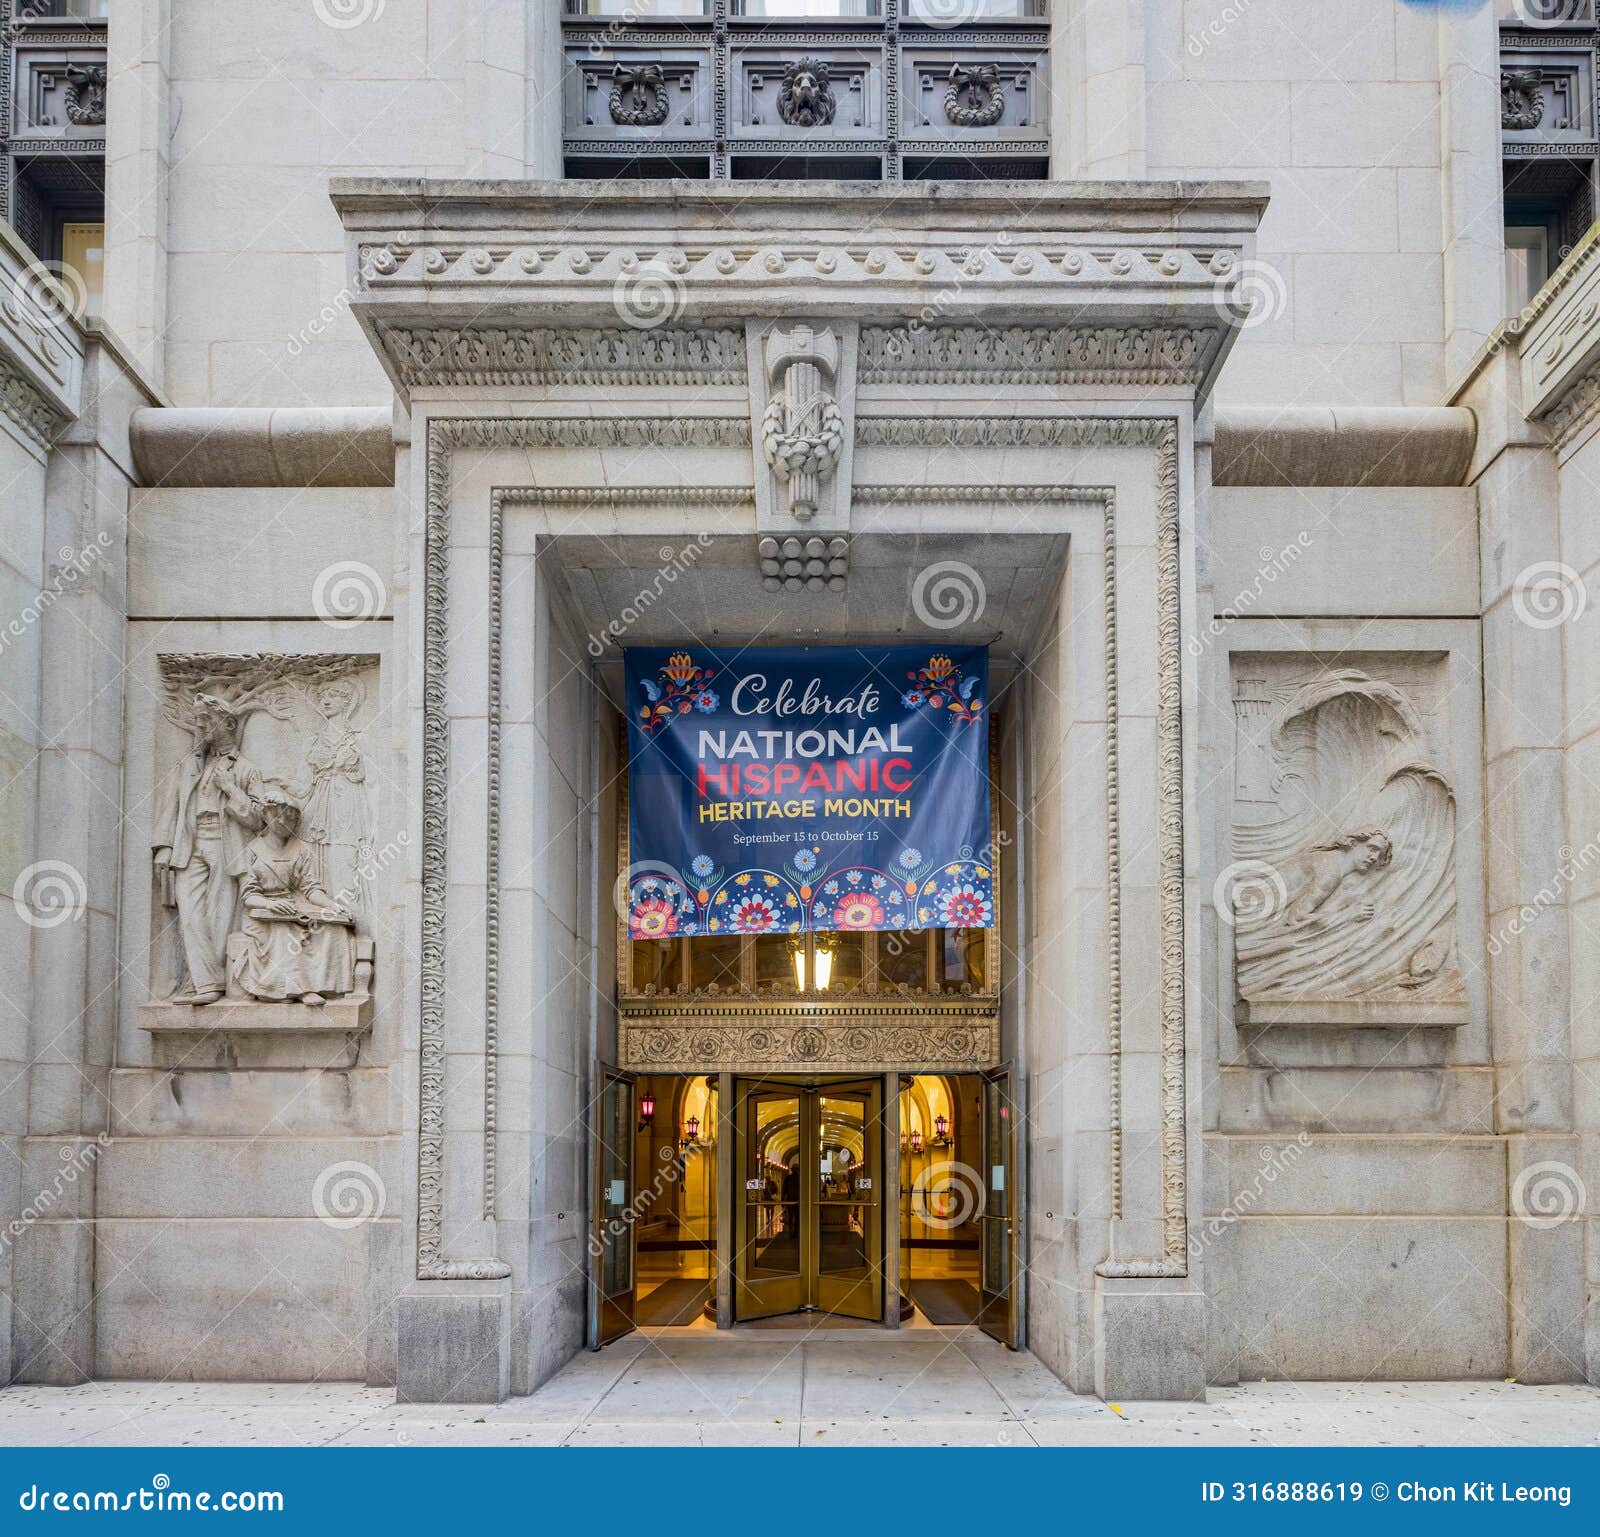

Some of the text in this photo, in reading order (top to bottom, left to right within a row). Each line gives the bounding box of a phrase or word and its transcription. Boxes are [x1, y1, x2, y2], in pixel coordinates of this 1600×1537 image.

[731, 673, 880, 719] Celebrate
[698, 723, 913, 760] NATIONAL
[697, 758, 913, 797] HISPANIC
[699, 798, 911, 823] HERITAGE MONTH
[733, 831, 879, 846] September 15 to October 15
